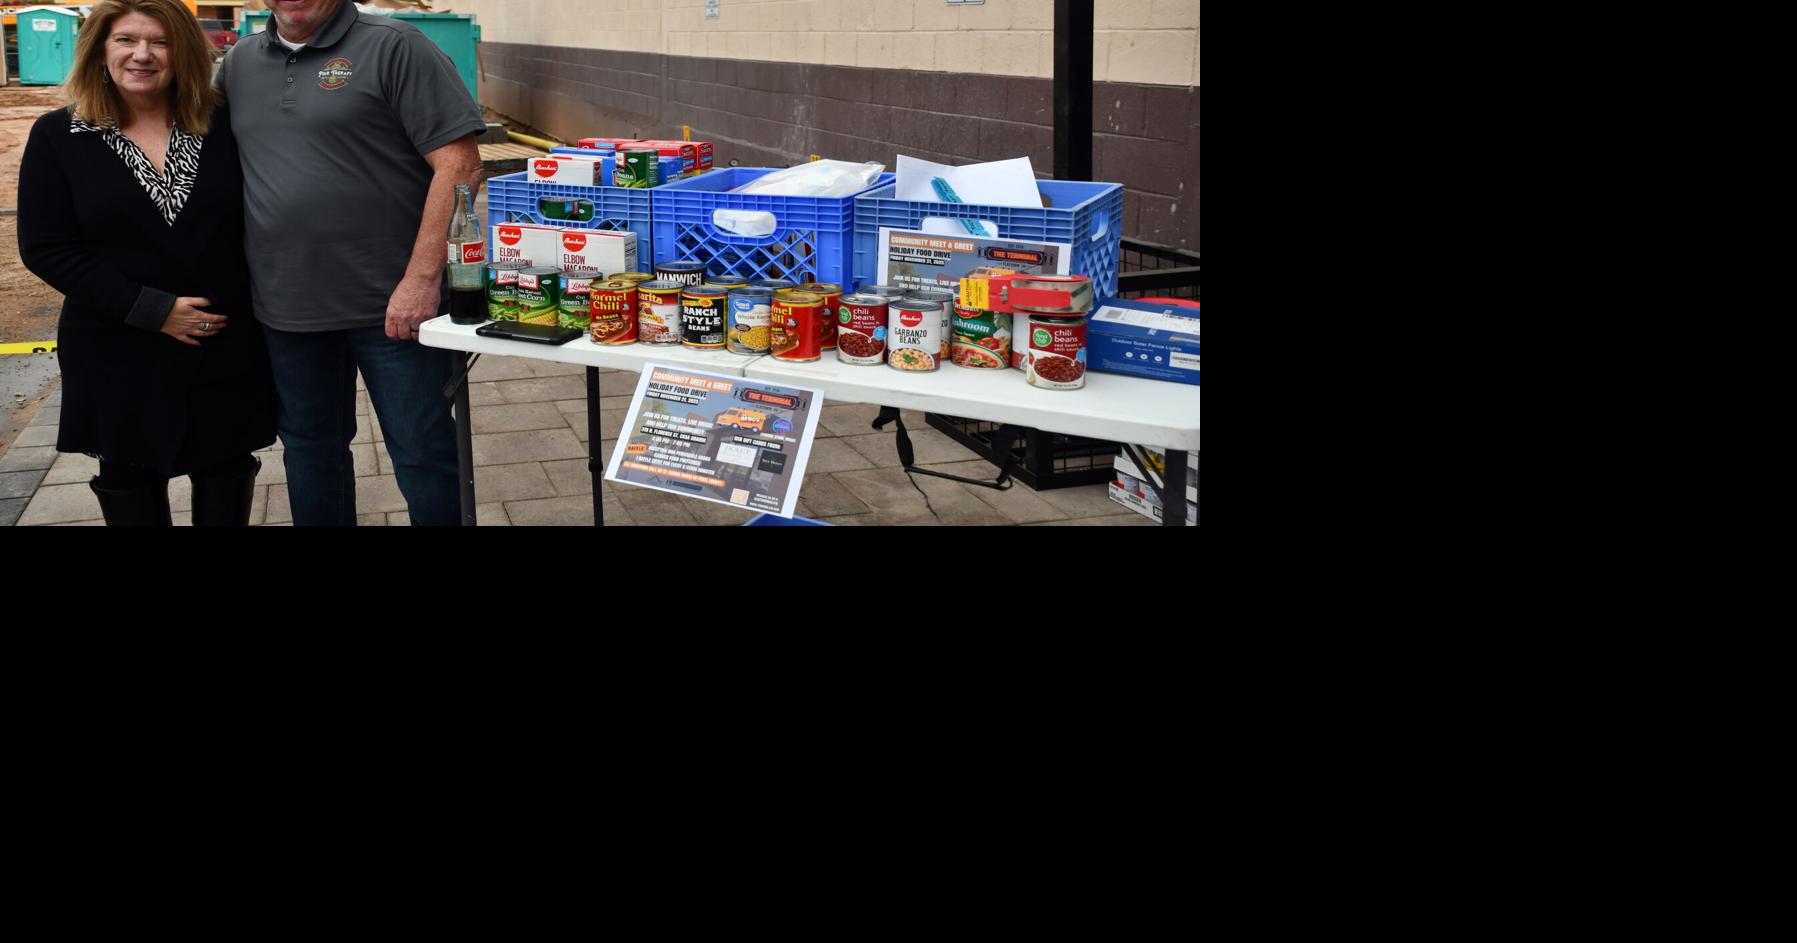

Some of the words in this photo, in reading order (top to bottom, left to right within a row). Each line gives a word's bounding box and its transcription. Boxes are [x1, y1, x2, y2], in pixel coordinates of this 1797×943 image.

[891, 236, 928, 246] COMMUNITY
[930, 240, 946, 248] MEET
[954, 242, 974, 250] GREET
[500, 247, 520, 257] ELBOW
[890, 247, 914, 255] HOLIDAY
[916, 249, 932, 257] FOOD
[1007, 252, 1038, 260] TERMINAL
[564, 254, 585, 265] ELBOW
[593, 301, 620, 310] Chili
[684, 306, 718, 316] RANCH
[682, 315, 721, 326] STYLE
[895, 328, 927, 338] GARBANZO
[900, 337, 920, 345] BEANS
[653, 372, 688, 384] COMMUNITY
[690, 377, 706, 387] MEET
[713, 382, 732, 392] GREET
[648, 383, 672, 392] HOLIDAY
[674, 386, 689, 394] FOOD
[690, 389, 708, 397] DRIVE
[748, 391, 760, 400] THE
